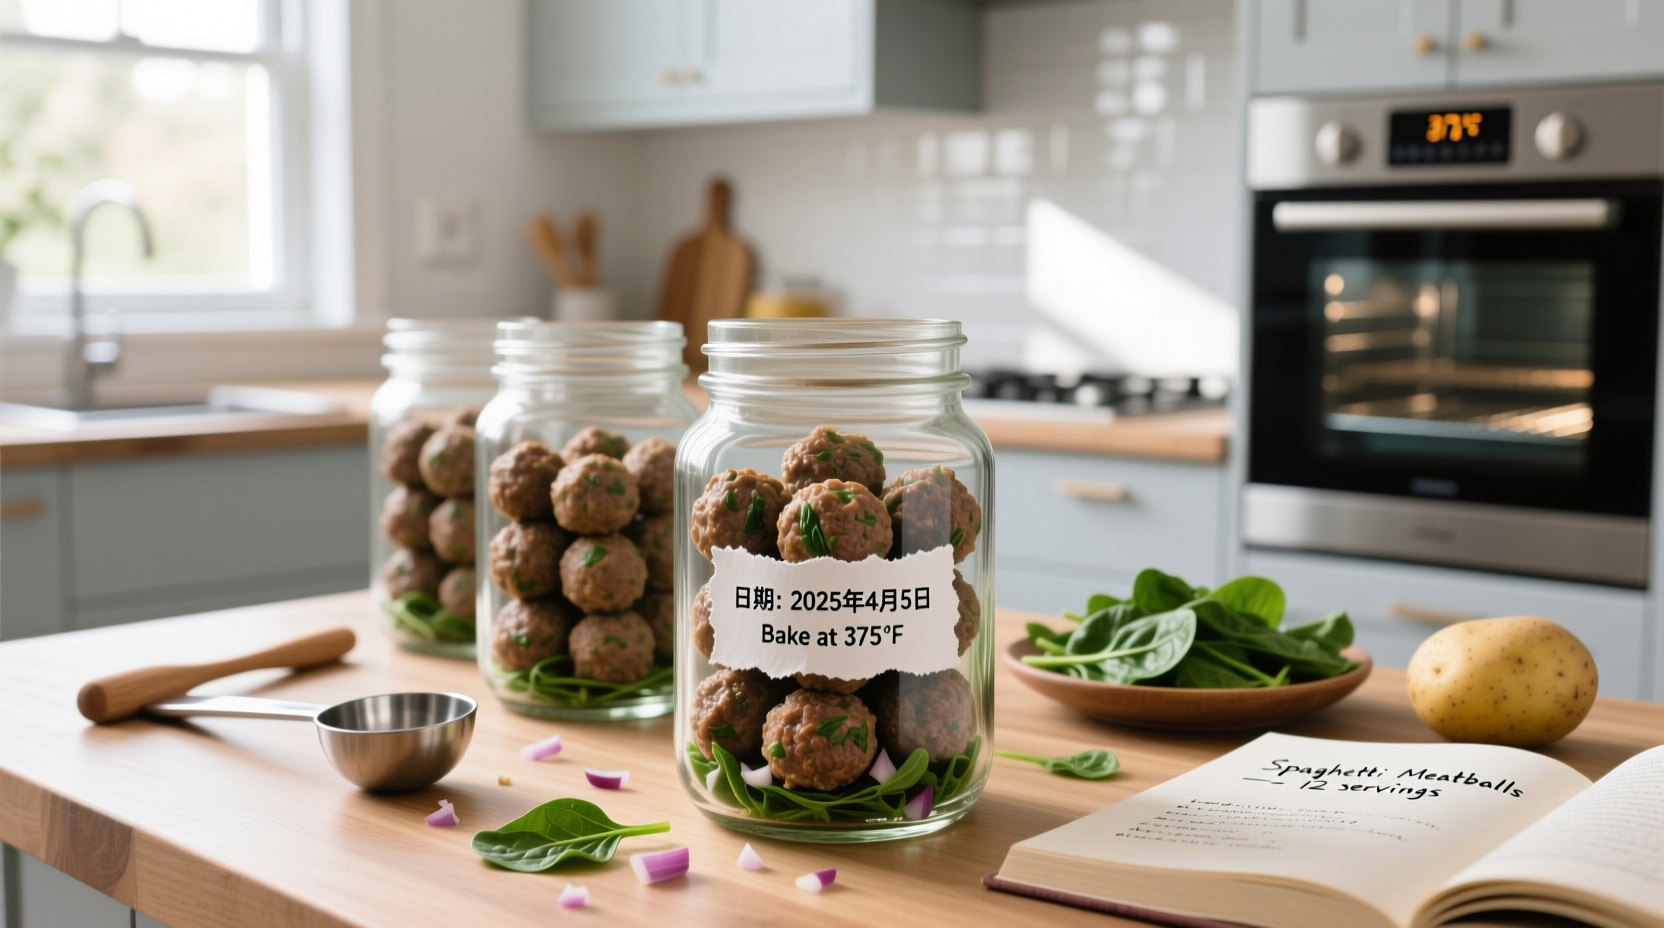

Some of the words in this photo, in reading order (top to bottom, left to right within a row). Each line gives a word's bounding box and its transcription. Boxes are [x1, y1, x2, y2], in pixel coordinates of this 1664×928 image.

[790, 587, 930, 614] 2025年4月5日
[761, 624, 811, 646] Bake
[816, 628, 838, 647] at
[844, 624, 904, 647] 375°F
[1262, 759, 1388, 779] Spaghetti
[1397, 769, 1524, 799] Meatballs
[1299, 780, 1328, 791] 12
[1337, 782, 1442, 800] servings
